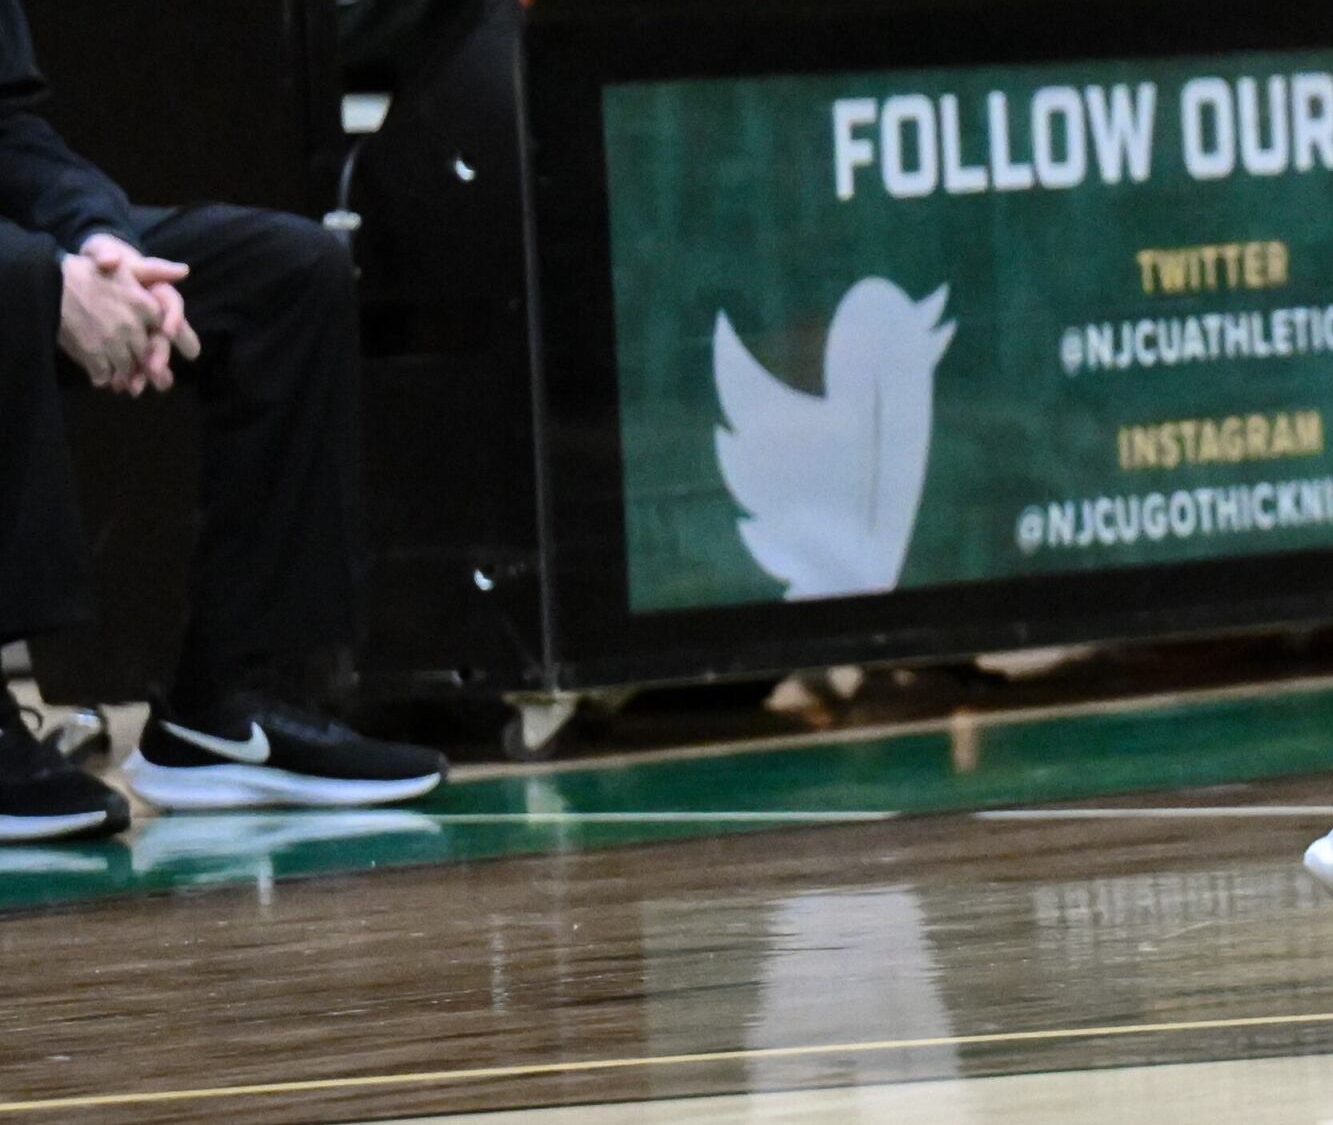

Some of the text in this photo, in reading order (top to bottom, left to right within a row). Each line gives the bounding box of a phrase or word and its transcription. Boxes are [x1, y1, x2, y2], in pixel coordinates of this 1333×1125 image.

[832, 81, 1157, 201] FOLLOW
[1136, 240, 1290, 295] TWITTER
[1117, 409, 1324, 471] INSTAGRAM
